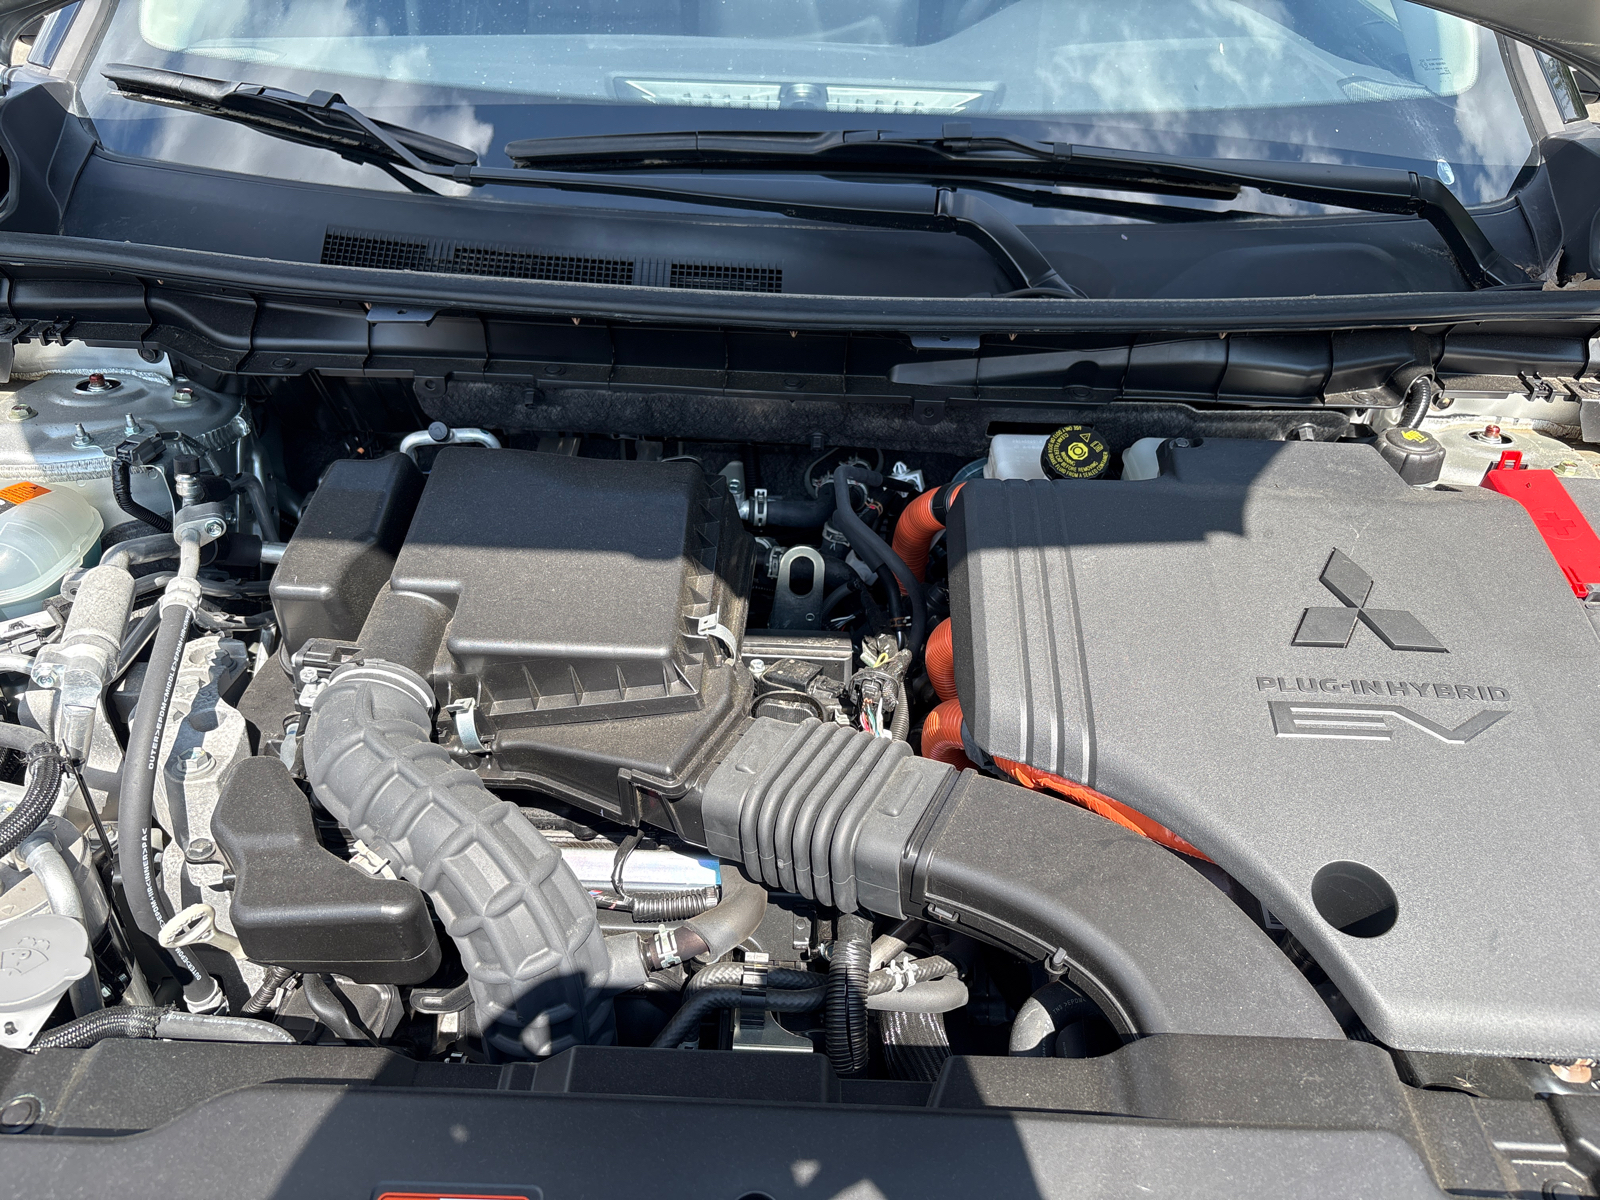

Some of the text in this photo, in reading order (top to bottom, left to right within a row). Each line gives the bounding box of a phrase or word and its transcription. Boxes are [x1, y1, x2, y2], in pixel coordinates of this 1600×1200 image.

[1057, 432, 1069, 443] CLEAN
[1048, 453, 1057, 465] BRAKE
[1055, 464, 1066, 473] FLUID
[1066, 470, 1079, 478] FROM
[1083, 468, 1098, 478] SEALED
[1097, 452, 1108, 471] CONTAINER
[1061, 452, 1075, 466] WARNING
[1060, 461, 1077, 472] BEFORE
[1078, 460, 1099, 472] REMOVING
[1267, 700, 1514, 744] EV
